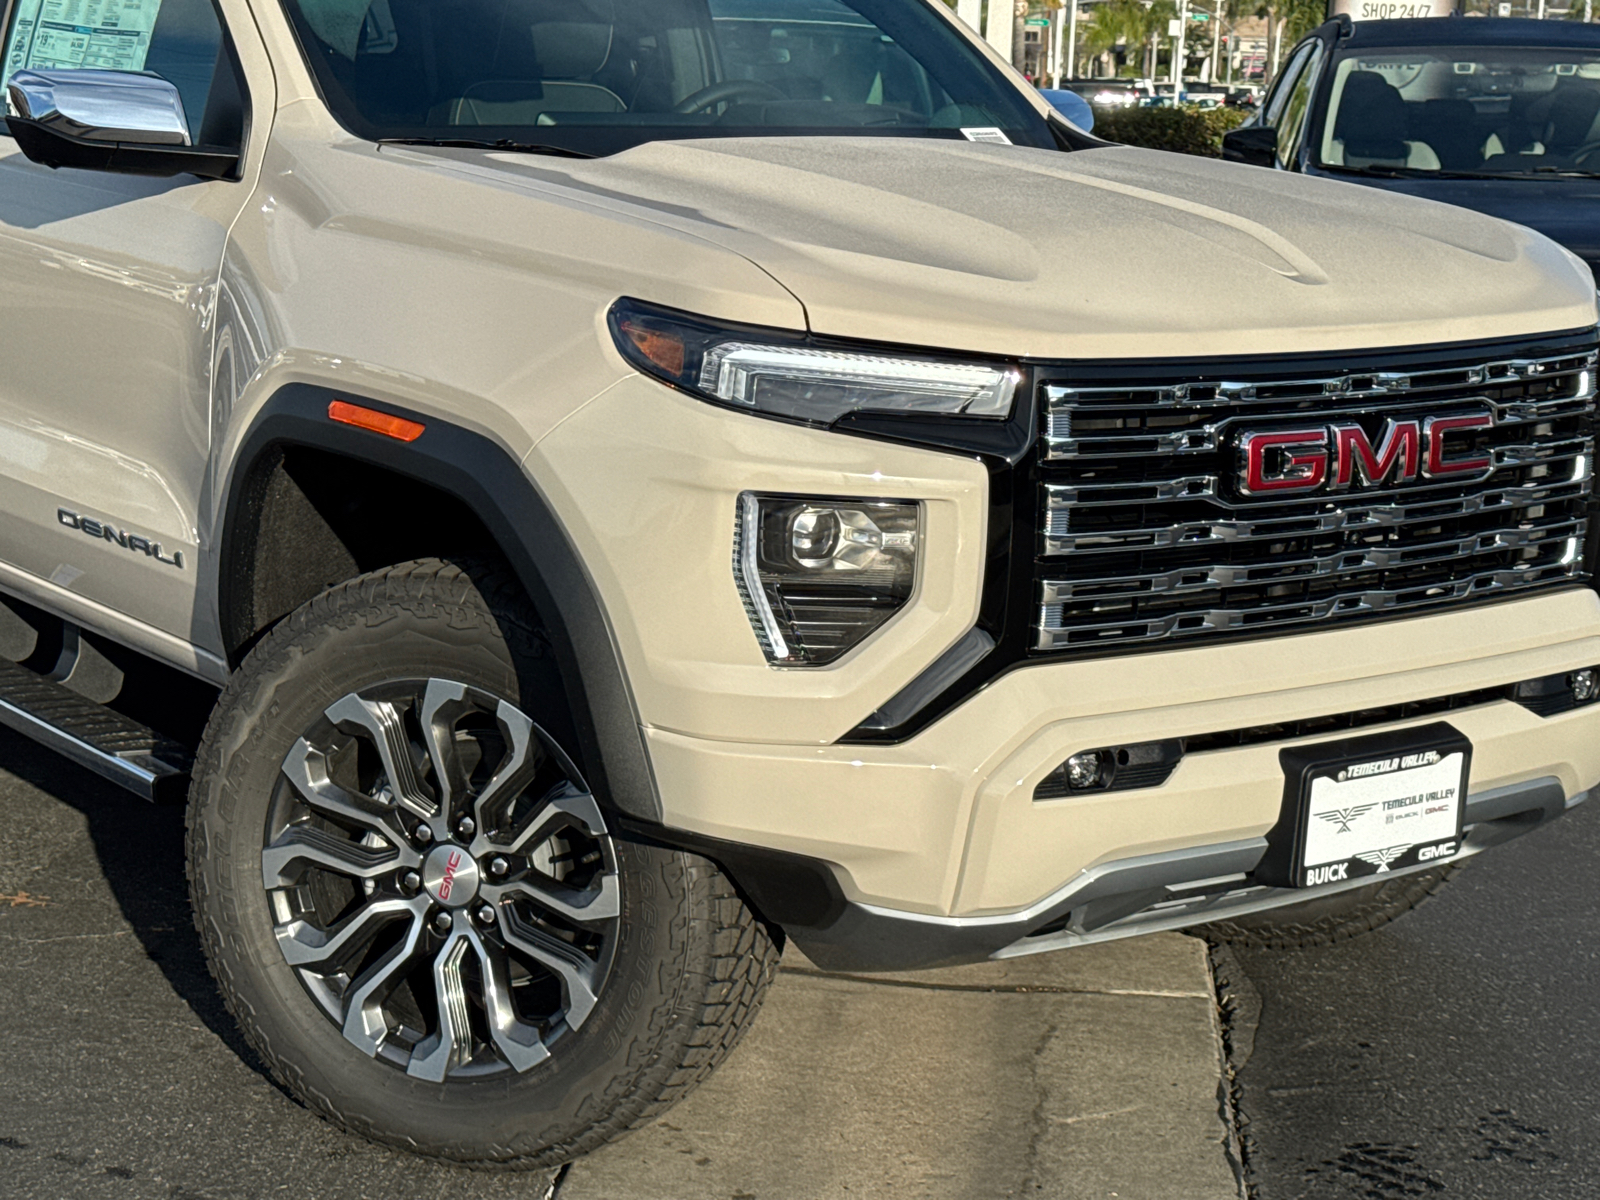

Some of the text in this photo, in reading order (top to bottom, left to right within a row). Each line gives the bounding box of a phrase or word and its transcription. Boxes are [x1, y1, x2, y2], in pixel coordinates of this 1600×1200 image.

[1361, 2, 1431, 19] SHOP 24/7
[1240, 412, 1494, 497] GMC
[57, 507, 186, 569] DENALI
[1347, 750, 1438, 778] TEMECULA VALLEY
[1382, 788, 1455, 811] TEMECULA VALLEY
[1395, 804, 1449, 820] BUICK GMC
[214, 752, 257, 966] DUELER
[1418, 842, 1456, 861] GMC
[438, 850, 463, 901] GMC
[1306, 862, 1348, 886] BUICK
[603, 842, 659, 1058] DGESTONE
